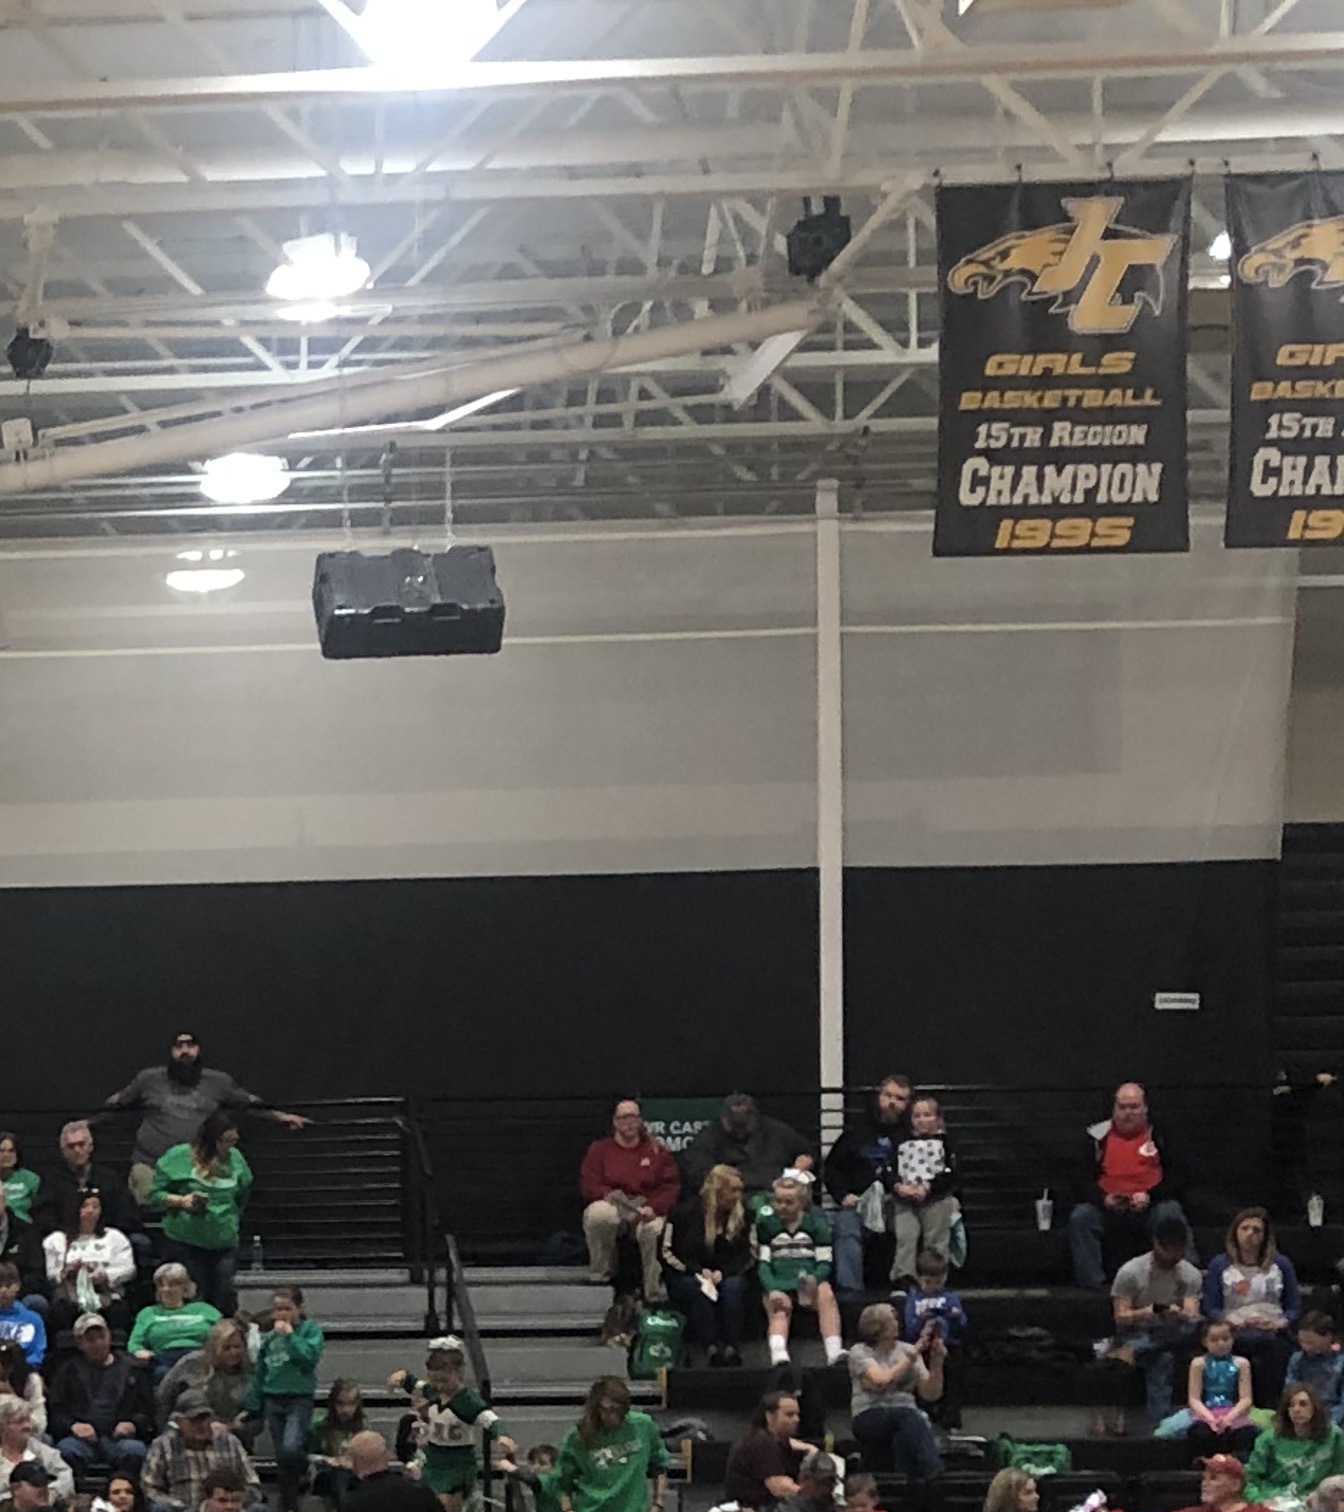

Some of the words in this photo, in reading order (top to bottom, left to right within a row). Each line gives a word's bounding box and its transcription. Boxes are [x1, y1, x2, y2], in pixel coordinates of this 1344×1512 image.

[984, 351, 1136, 376] GIRLS
[958, 386, 1162, 410] BASKETBALL
[974, 421, 1044, 449] 15TH
[1049, 421, 1148, 448] REGION
[1265, 412, 1335, 440] 15TH
[958, 456, 1163, 506] CHAMPION
[994, 516, 1135, 548] 1995
